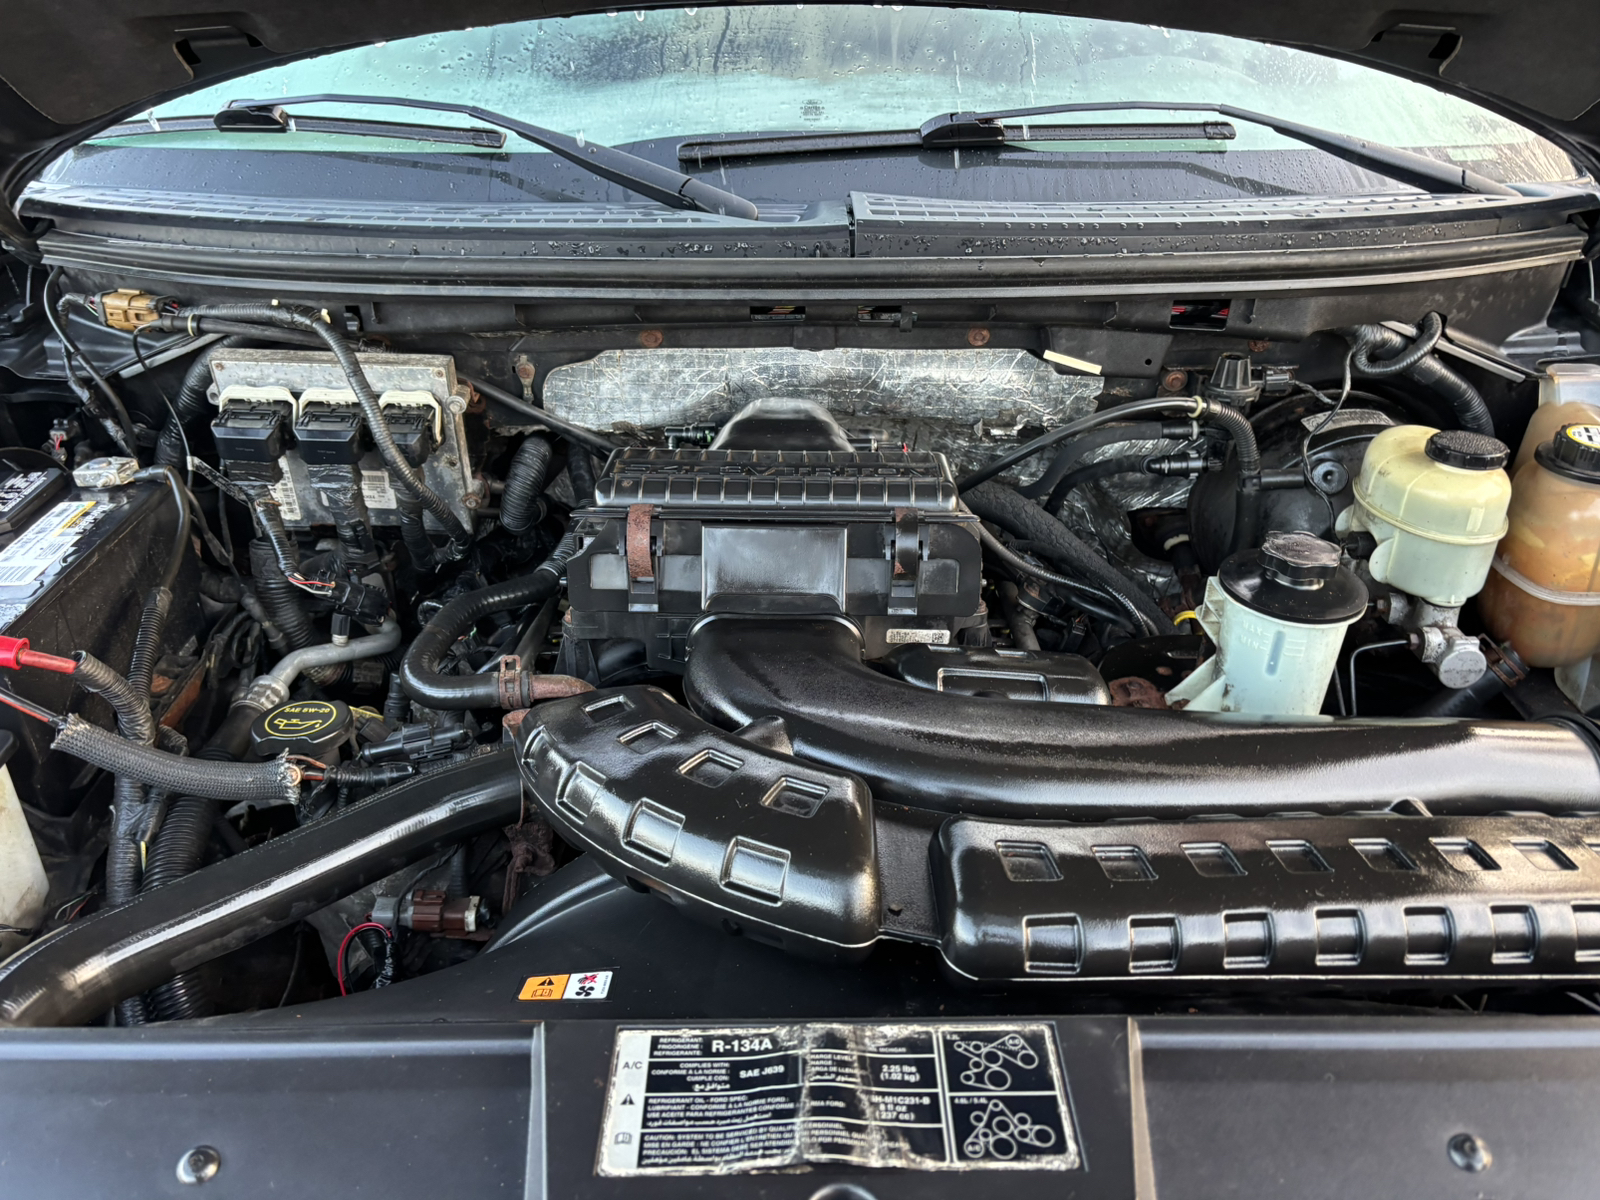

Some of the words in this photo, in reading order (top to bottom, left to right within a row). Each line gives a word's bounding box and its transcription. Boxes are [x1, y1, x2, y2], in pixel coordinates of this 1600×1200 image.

[1242, 620, 1263, 636] MAX
[1240, 634, 1260, 650] MIN
[711, 1038, 773, 1053] R-134A
[622, 1061, 643, 1069] A/C
[882, 1064, 901, 1072] 2.25
[902, 1064, 917, 1073] lbs
[739, 1068, 760, 1079] SAE
[761, 1065, 785, 1075] J639
[880, 1072, 902, 1081] (1.02
[904, 1072, 921, 1083] kg)
[879, 1103, 886, 1111] 8
